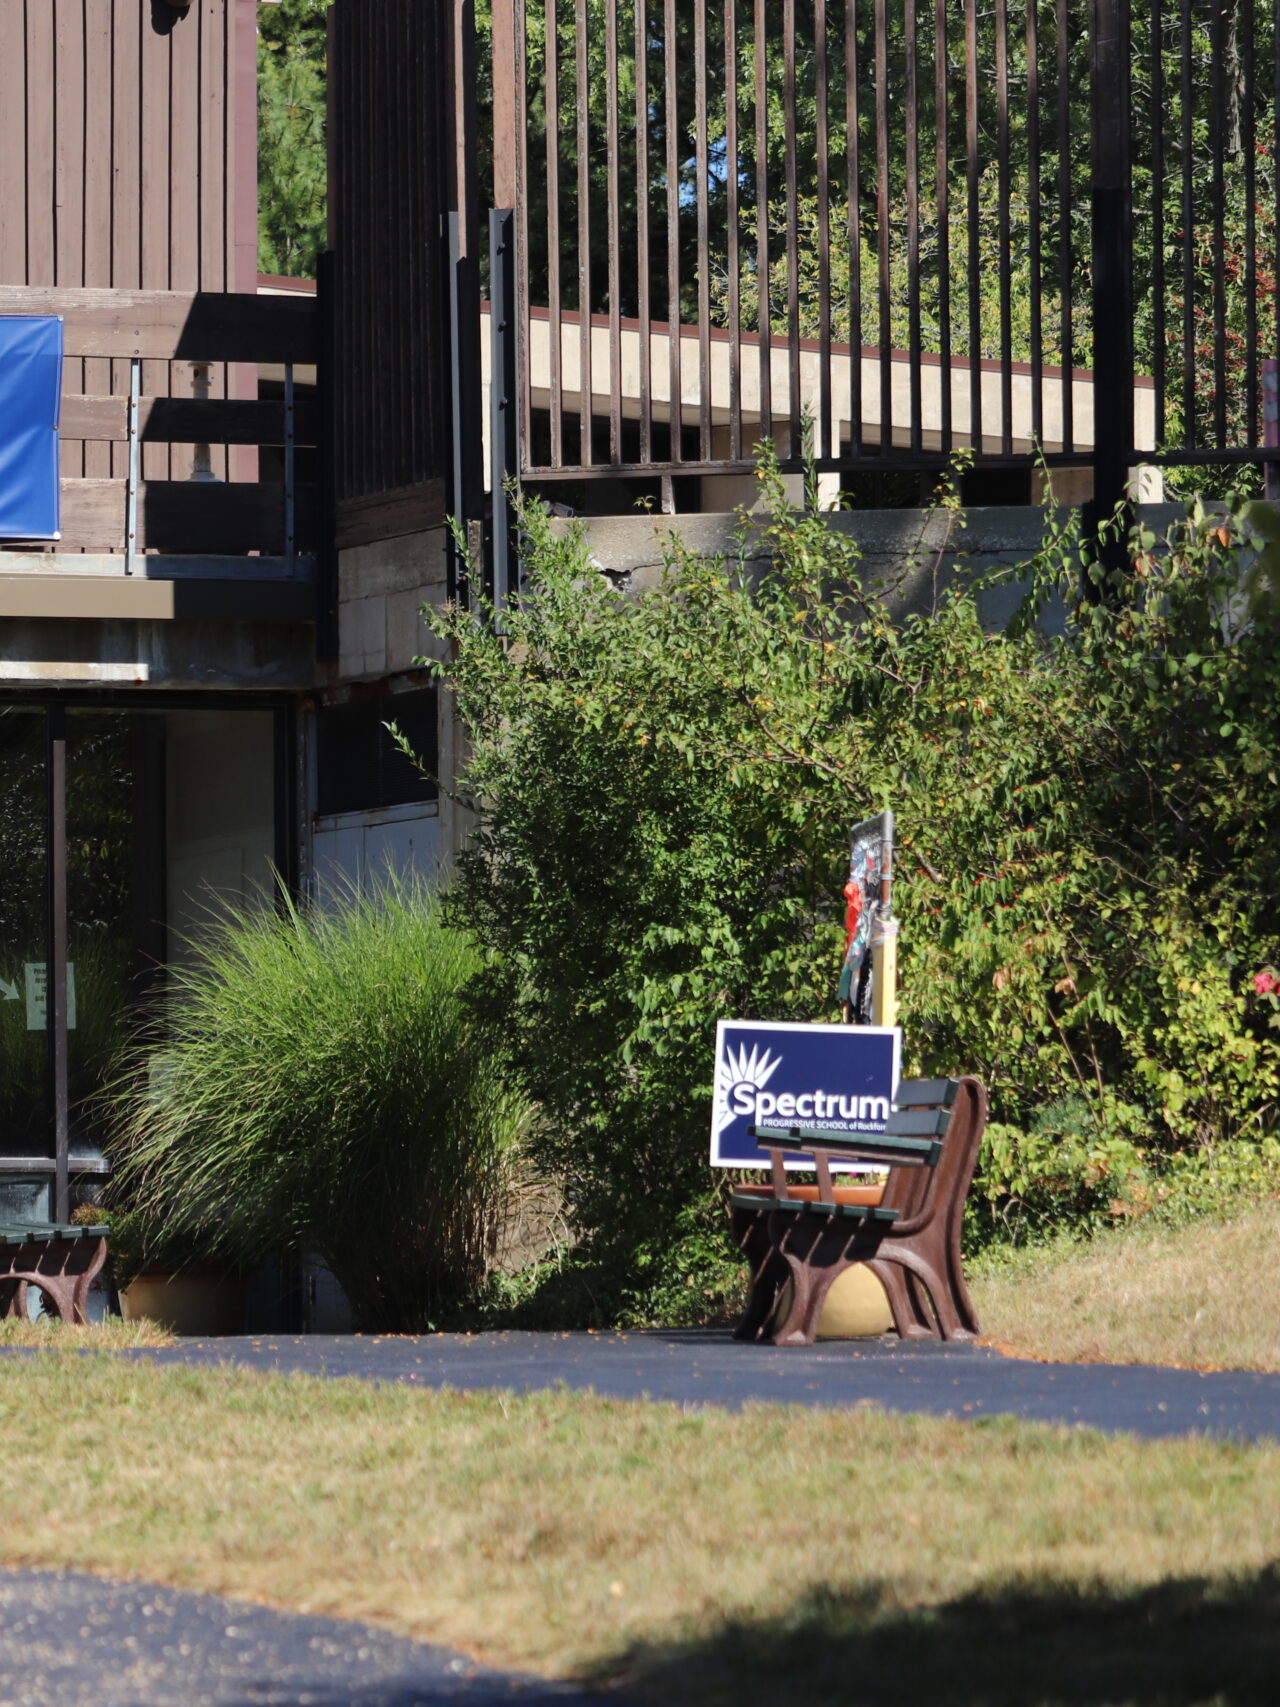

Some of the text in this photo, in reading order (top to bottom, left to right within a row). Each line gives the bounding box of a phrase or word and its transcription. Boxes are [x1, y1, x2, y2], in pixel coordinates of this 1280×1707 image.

[733, 1083, 889, 1126] Spectrum
[763, 1118, 815, 1129] PROGRESSIVE
[816, 1120, 848, 1130] SCHOOL
[849, 1121, 857, 1130] of
